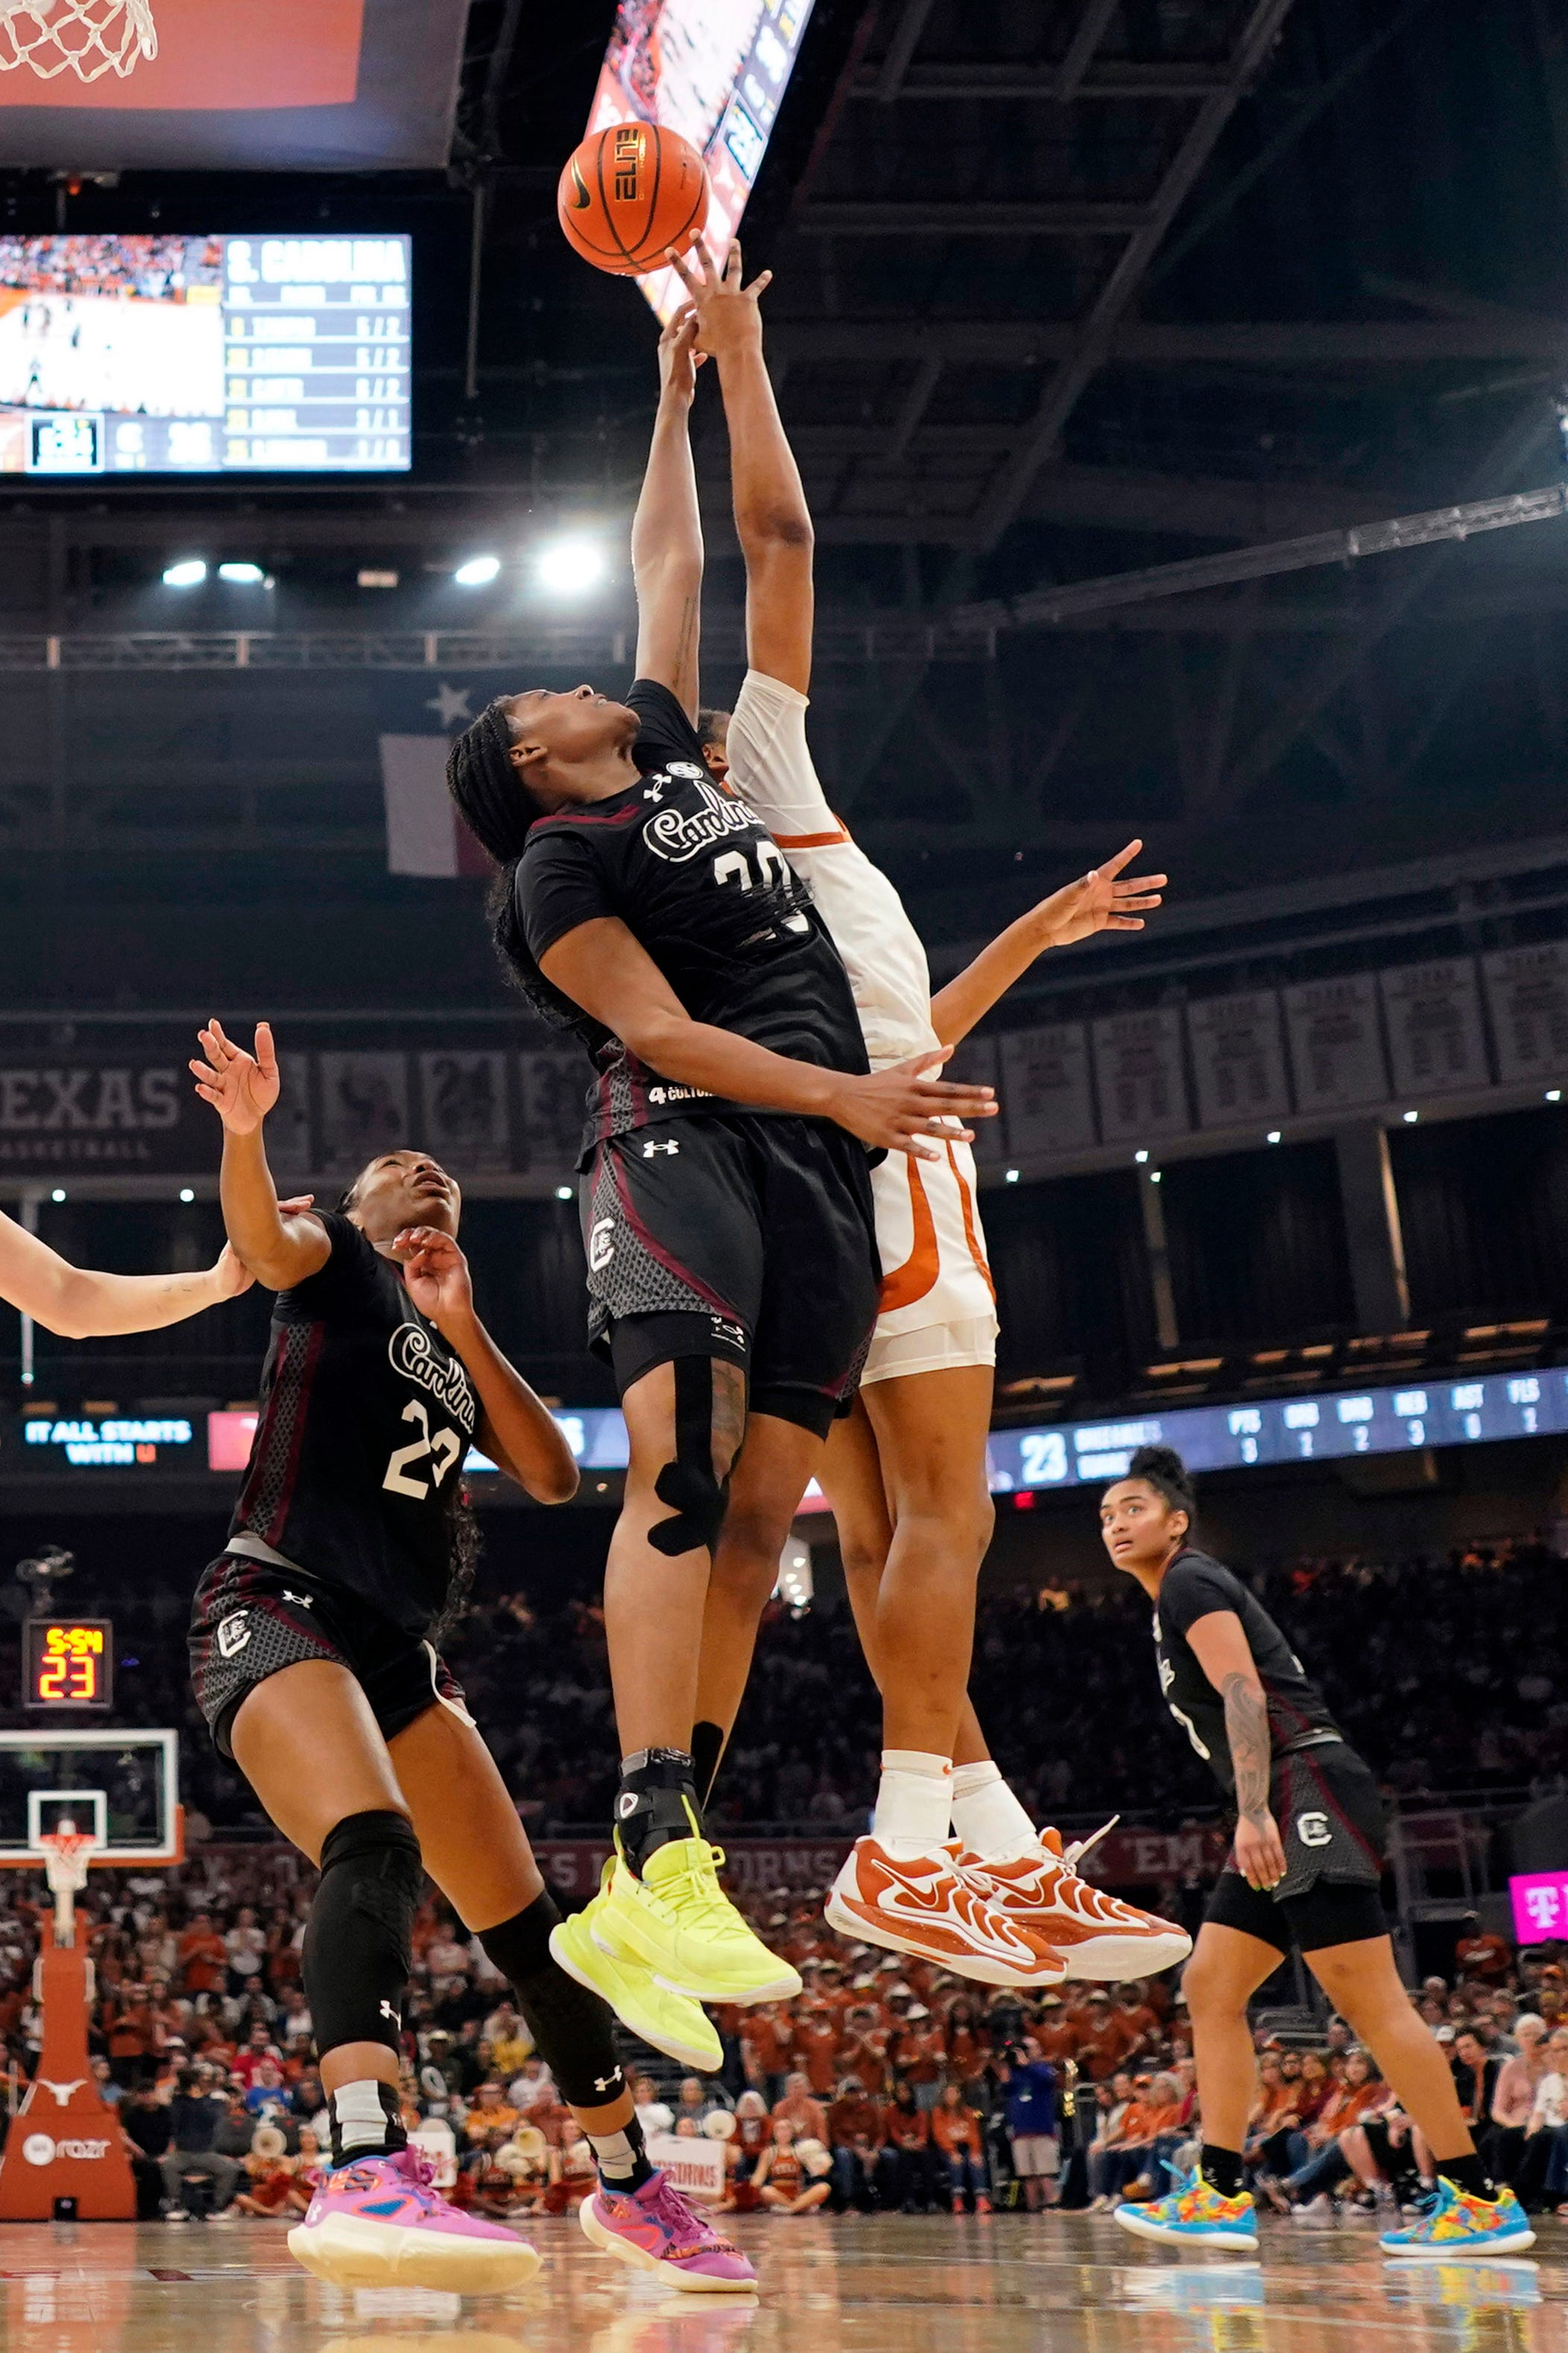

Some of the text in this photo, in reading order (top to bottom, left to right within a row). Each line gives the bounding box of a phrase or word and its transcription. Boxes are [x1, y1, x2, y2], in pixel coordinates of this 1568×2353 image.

[615, 128, 639, 202] ELITE
[648, 1087, 715, 1105] 4 CULTU
[51, 1421, 99, 1443] ALL
[100, 1420, 192, 1443] STARTS
[1353, 1425, 1369, 1451] 2
[66, 1443, 134, 1465] WITH
[1019, 1432, 1069, 1484] 23
[47, 1628, 103, 1654] 5:54
[39, 1655, 95, 1699] 23
